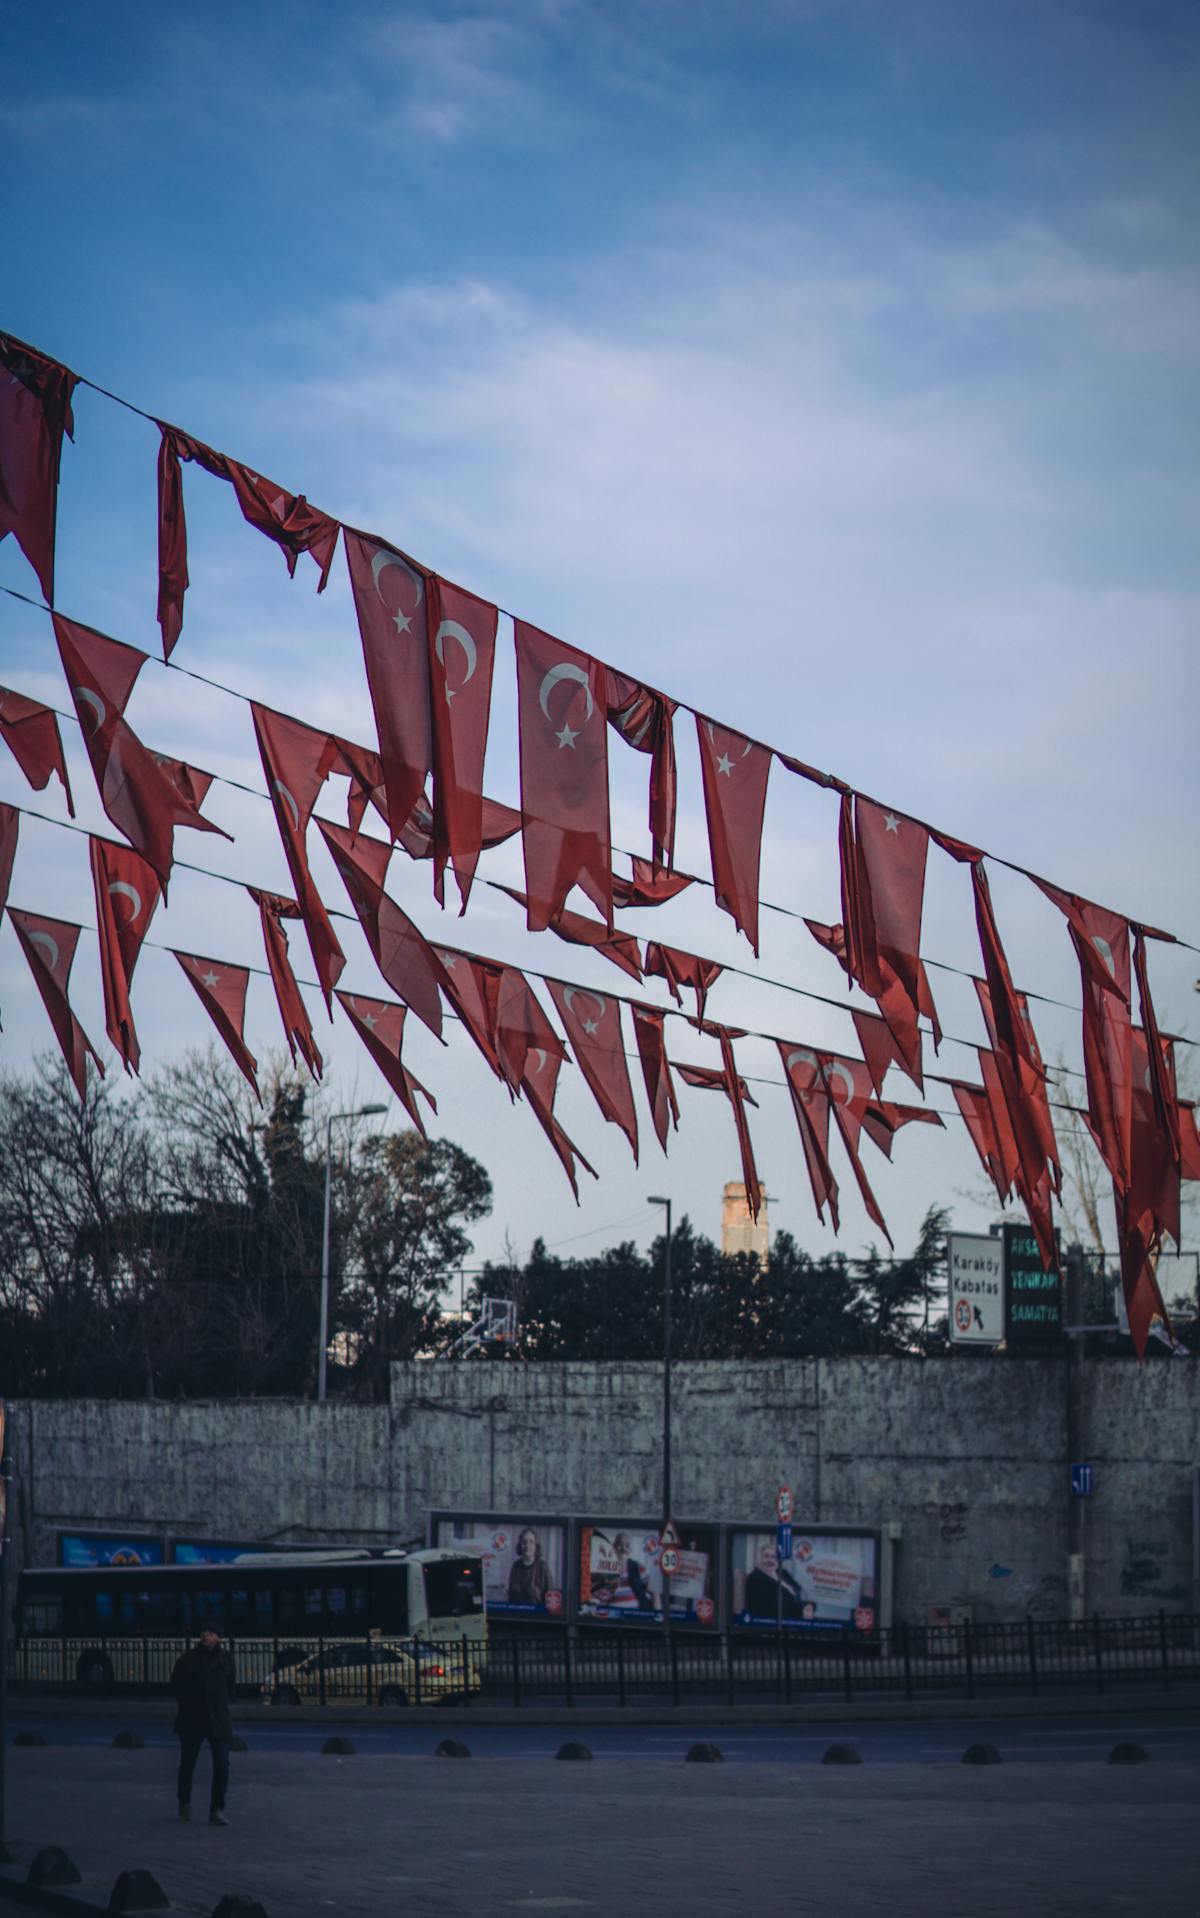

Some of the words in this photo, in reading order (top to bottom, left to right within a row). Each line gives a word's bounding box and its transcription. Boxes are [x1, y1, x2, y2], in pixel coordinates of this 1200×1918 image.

[953, 1254, 1000, 1276] Karaköy
[1010, 1303, 1058, 1322] SAMATYA
[663, 1554, 676, 1567] 30
